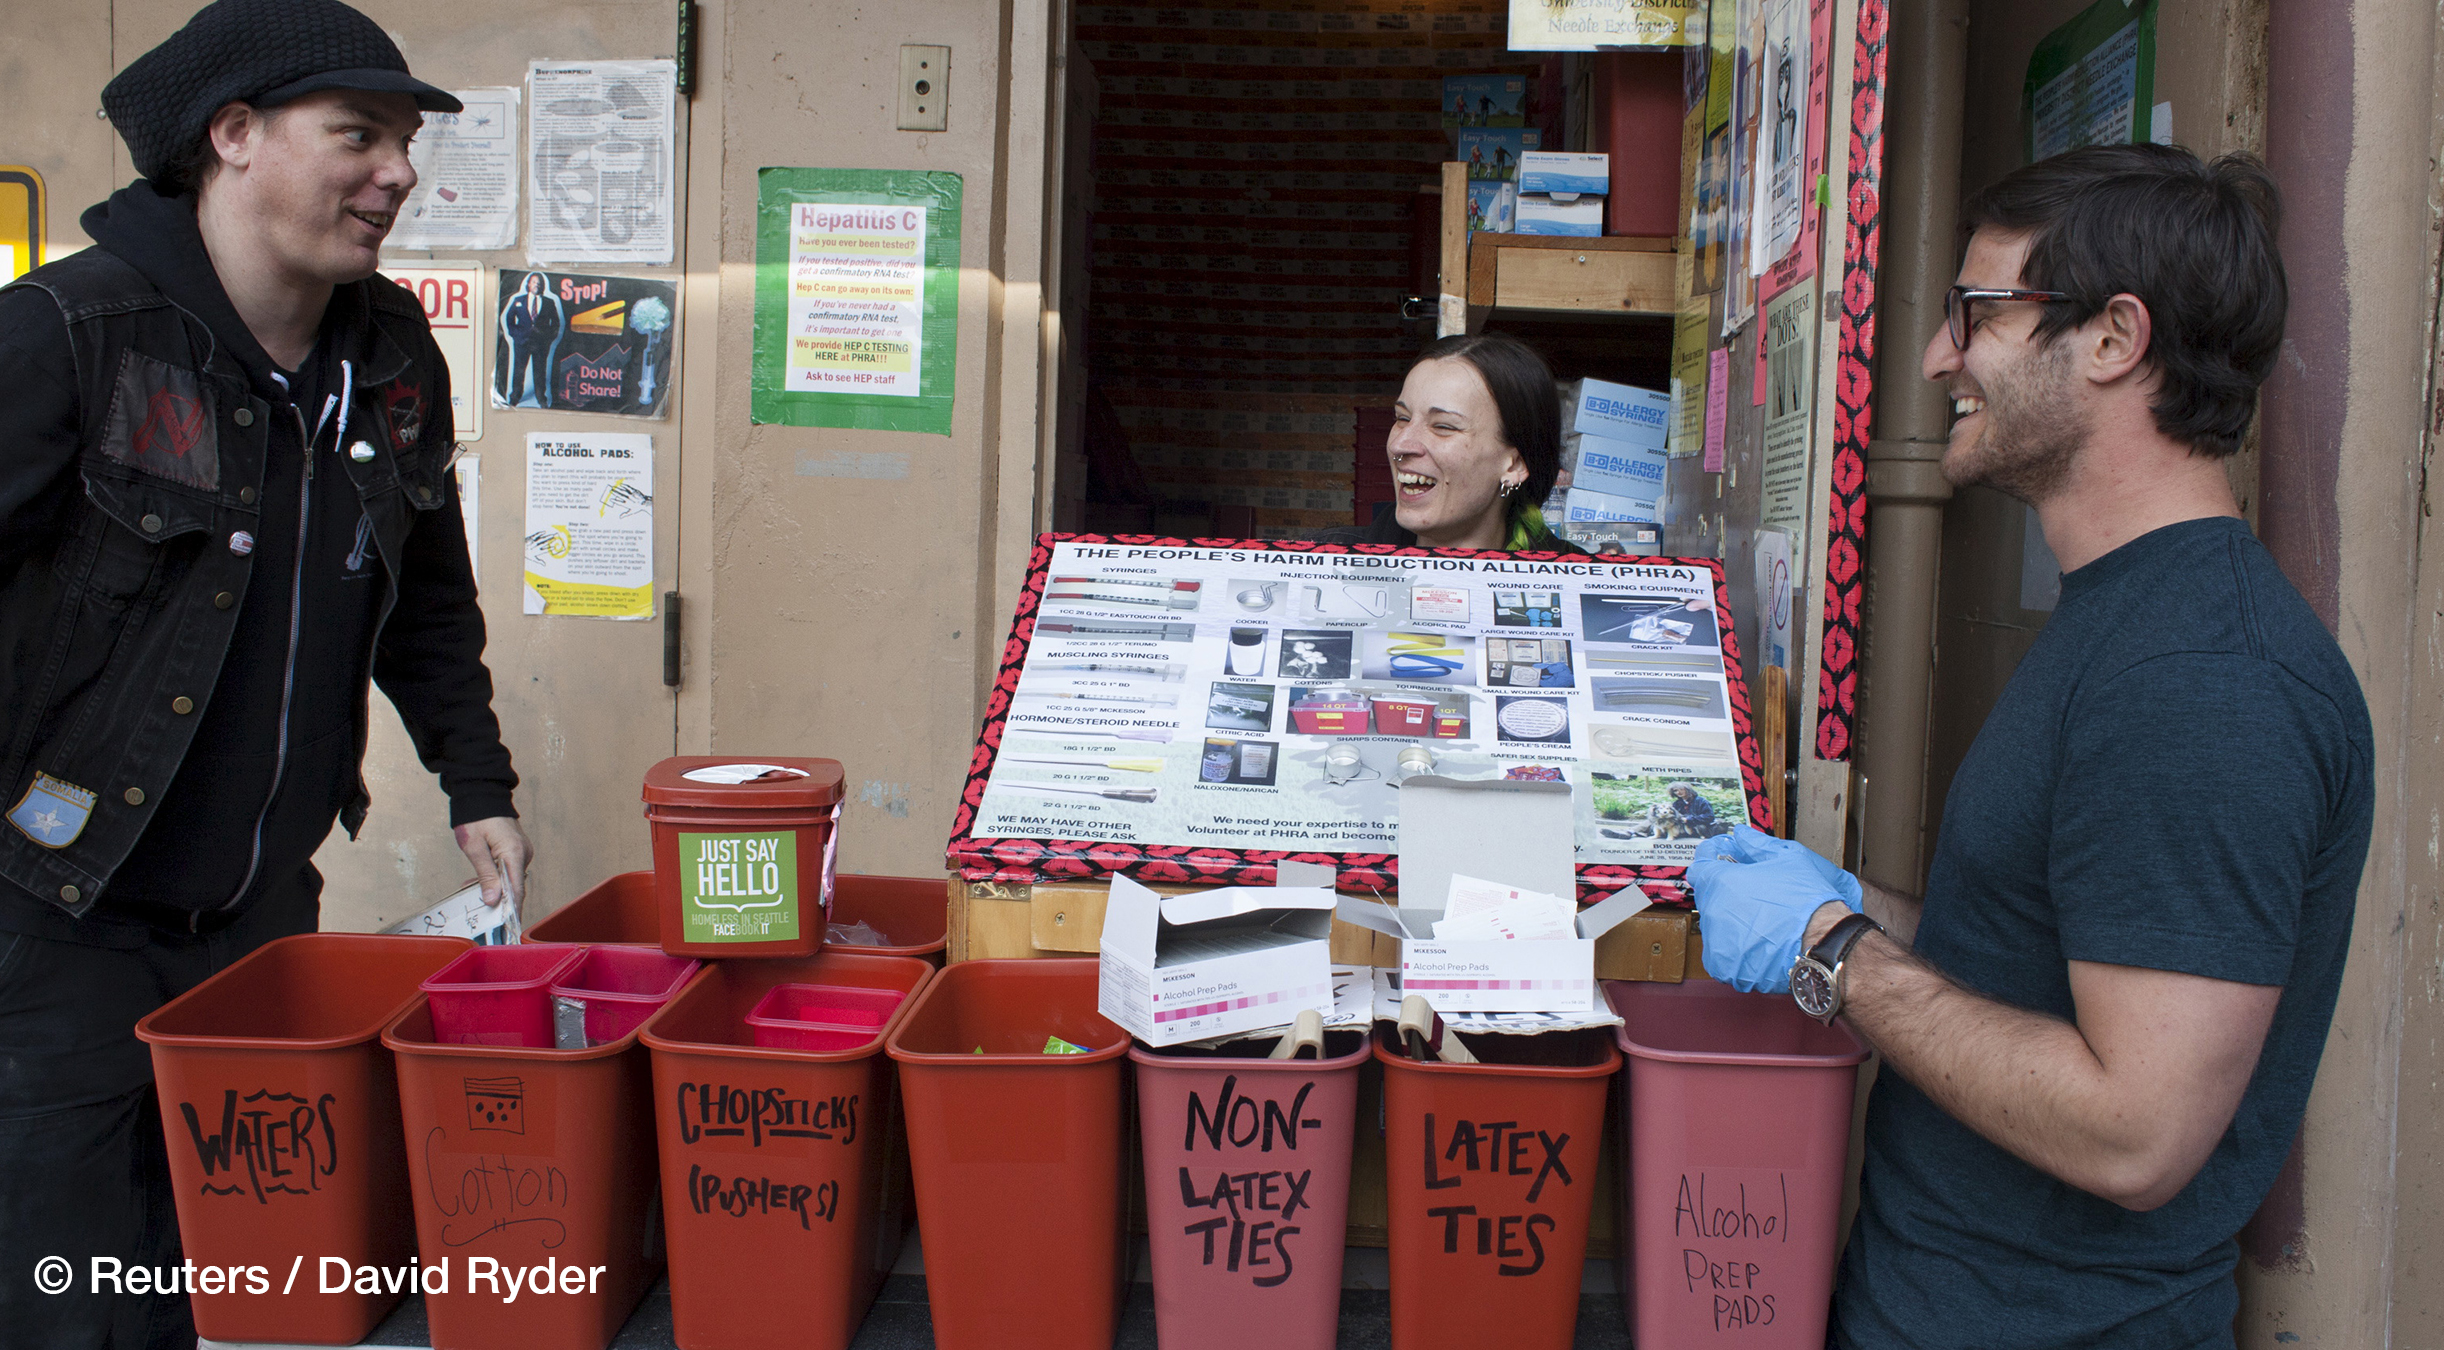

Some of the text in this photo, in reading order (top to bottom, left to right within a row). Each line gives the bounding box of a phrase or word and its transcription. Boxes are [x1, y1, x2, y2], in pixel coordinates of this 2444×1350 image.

[1548, 13, 1678, 40] Needle Exchange
[801, 207, 916, 232] Hepatitis C
[799, 237, 915, 249] Have you ever been tested?
[820, 268, 890, 278] confirmatory RNA
[797, 283, 812, 292] Hep
[838, 286, 847, 294] go
[850, 286, 868, 294] away
[808, 312, 859, 322] confirmatory
[861, 314, 878, 322] RNA
[796, 339, 908, 353] We provide HEP C TESTING
[815, 352, 838, 360] HERE
[852, 353, 887, 363] PHRA!!!
[580, 365, 622, 380] Do Not
[806, 371, 895, 384] Ask to see HEP staff
[579, 383, 621, 397] Share!
[1611, 401, 1665, 417] ALLERGY
[1610, 409, 1663, 425] SYRINGE
[543, 449, 634, 458] ALCOHOL PADS:
[1609, 456, 1664, 473] ALLERGY
[1609, 465, 1662, 480] SYRINGE
[1074, 548, 1695, 582] THE PEOPLE'S HARM REDUCTION ALLIANCE (PHRA)
[1280, 572, 1406, 582] INJECTION EQUIPMENT
[1584, 583, 1705, 595] SMOKING EQUIPMENT
[1111, 652, 1169, 660] SYRINGES
[1396, 684, 1452, 692] TOURNIQUETS
[1010, 714, 1180, 728] HORMONE/STEROID NEEDLE
[43, 780, 86, 804] SOMALIA
[1194, 785, 1279, 793] NALOXONE/NARCAN
[998, 815, 1131, 830] WE MAY HAVE OTHER
[1214, 815, 1233, 824] We
[1237, 816, 1269, 826] need
[1273, 818, 1303, 828] your
[1307, 819, 1367, 830] expertise
[1372, 820, 1384, 829] to
[987, 825, 1136, 840] SYRINGES, PLEASE ASK
[1187, 825, 1395, 841] Volunteer at PHRA and become
[697, 838, 779, 862] JUST SAY
[698, 862, 779, 896] HELLO
[692, 912, 789, 925] HOMELESS IN SEATTLE
[714, 923, 769, 936] FACEBOOK IT
[1414, 962, 1489, 972] Alcohol Prep Pads
[1164, 987, 1196, 1000] Alcohol
[1197, 984, 1216, 996] Prep
[1218, 981, 1237, 993] Pads
[678, 1082, 858, 1147] CHOPSTICKS
[1185, 1075, 1321, 1152] NON-
[180, 1090, 337, 1204] WATERS
[1424, 1113, 1571, 1203] LATEX
[425, 1127, 567, 1217] Cotton
[1179, 1167, 1310, 1219] LATEX
[1675, 1173, 1789, 1243] Alcohol
[1428, 1206, 1555, 1277] TIES
[1184, 1217, 1300, 1287] TIES
[1684, 1248, 1760, 1292] PREP
[1713, 1293, 1776, 1332] PADS
